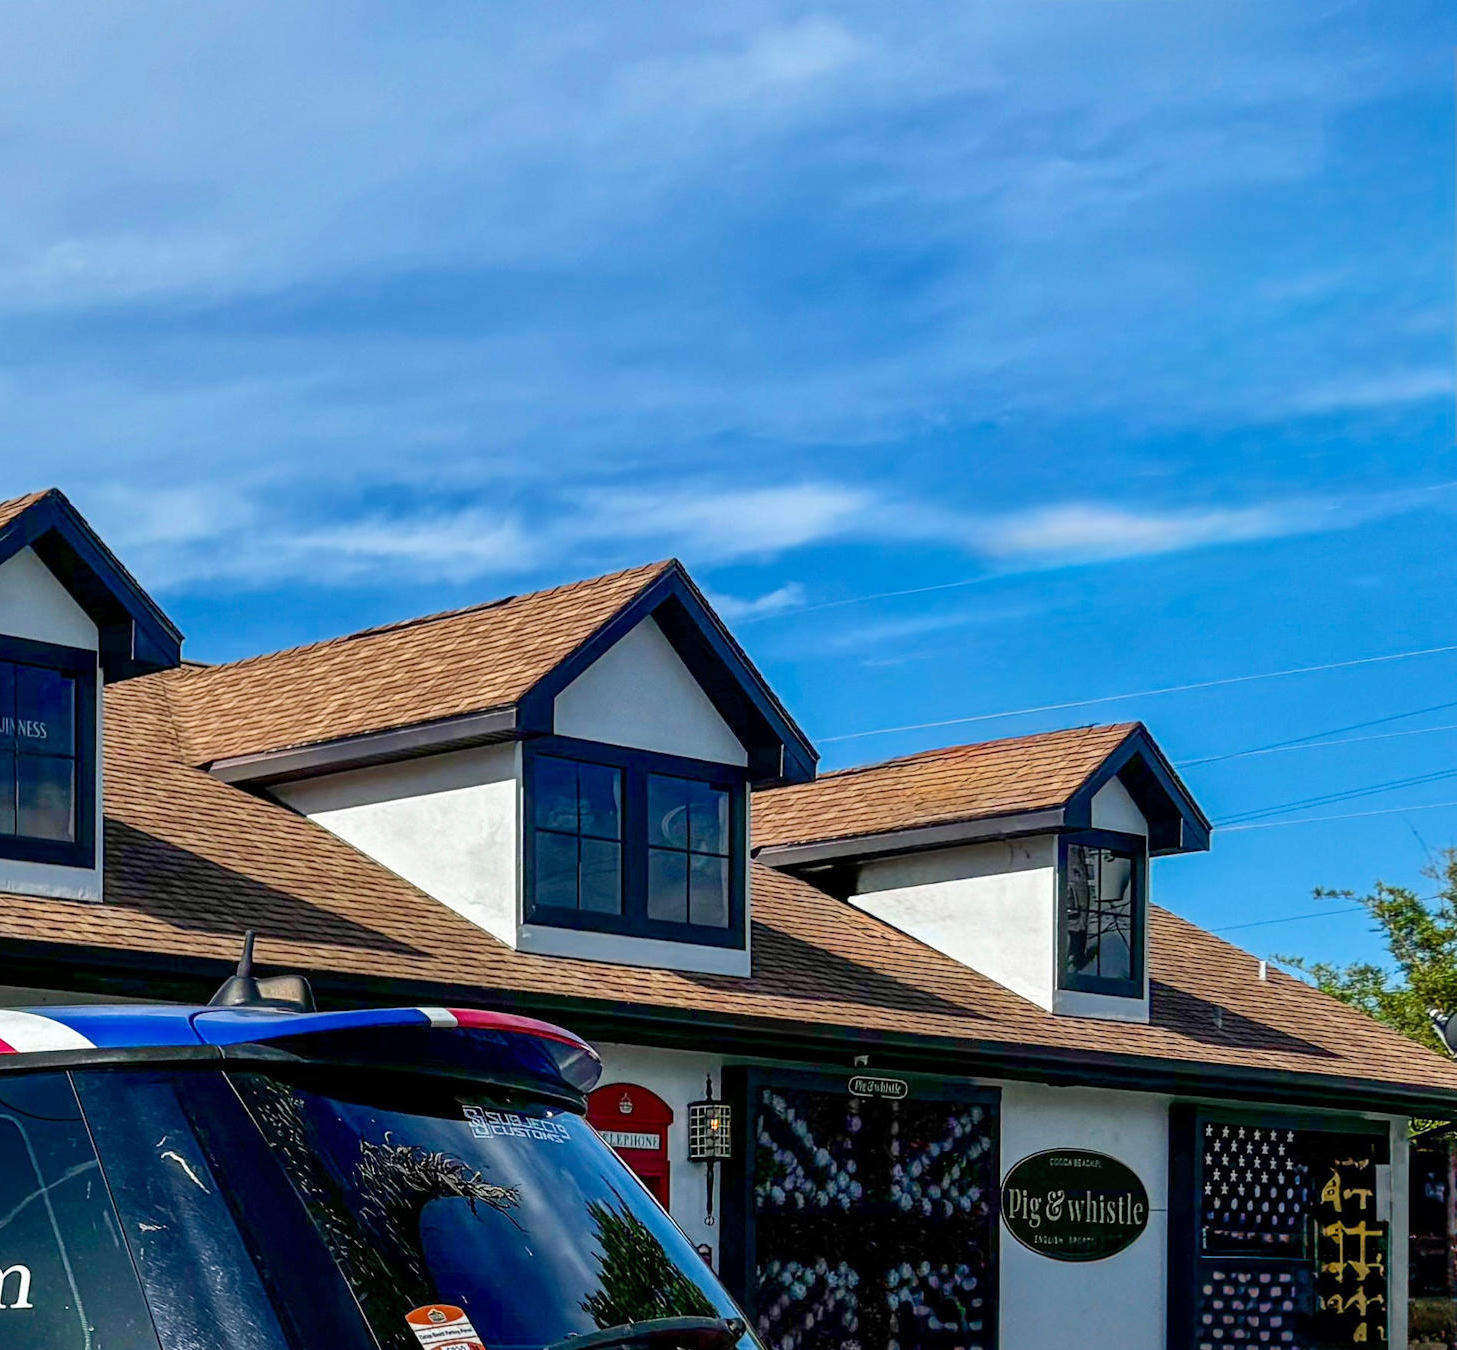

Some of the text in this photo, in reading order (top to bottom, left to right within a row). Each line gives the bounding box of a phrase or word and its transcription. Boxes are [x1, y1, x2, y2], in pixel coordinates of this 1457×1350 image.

[491, 1125, 565, 1144] CUSTOMS
[601, 1132, 660, 1149] ELEPHONE
[1008, 1188, 1144, 1228] Pig & whistle
